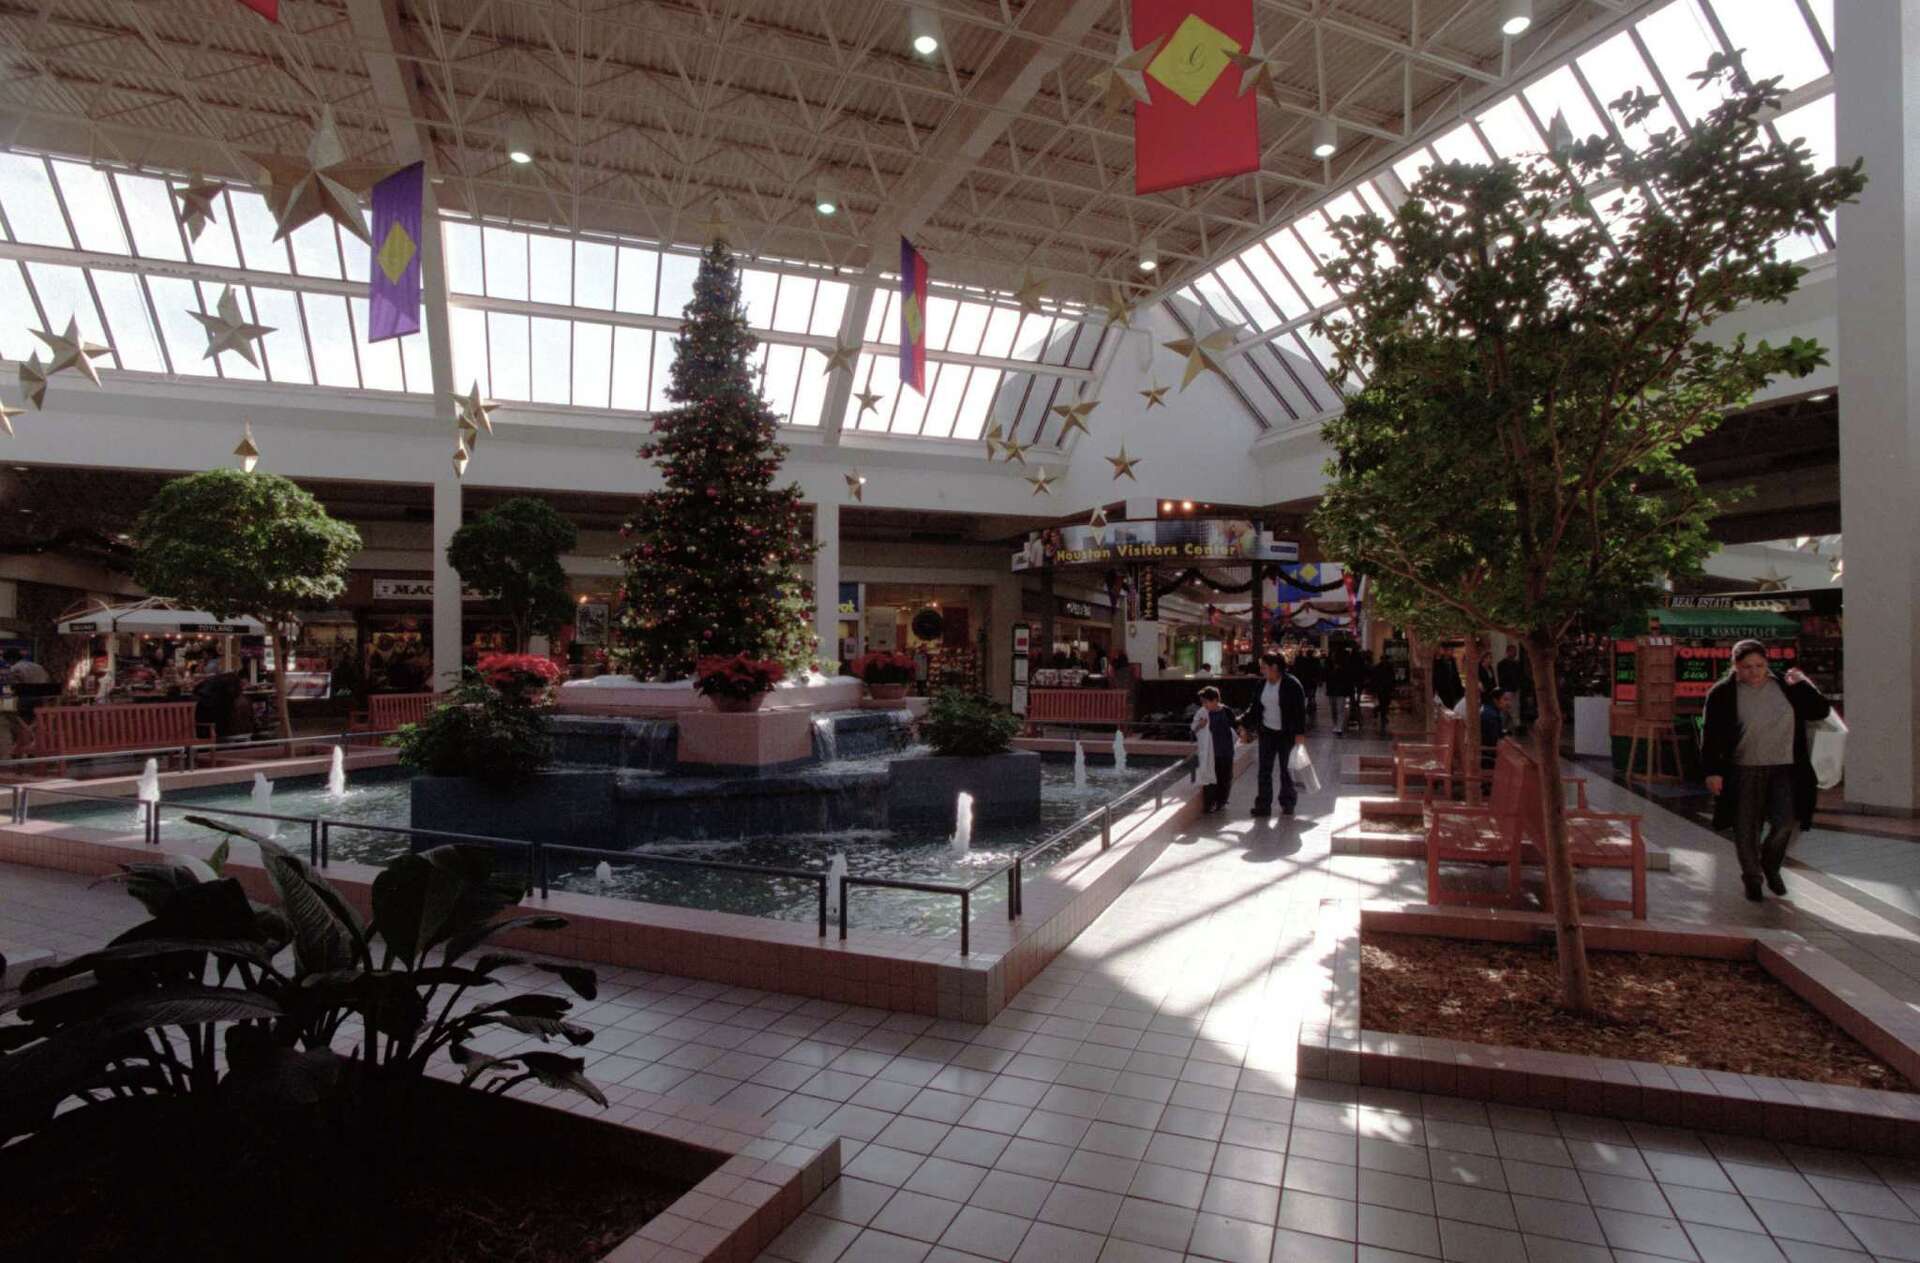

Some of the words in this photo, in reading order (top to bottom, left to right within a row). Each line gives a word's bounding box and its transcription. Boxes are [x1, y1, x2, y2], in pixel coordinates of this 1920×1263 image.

[1057, 549, 1110, 561] Houston
[1117, 544, 1178, 557] Visitors
[1185, 543, 1236, 555] Center
[1672, 597, 1694, 608] REAL
[1697, 597, 1732, 608] ESTATE
[1712, 627, 1777, 638] MARKETPLACE
